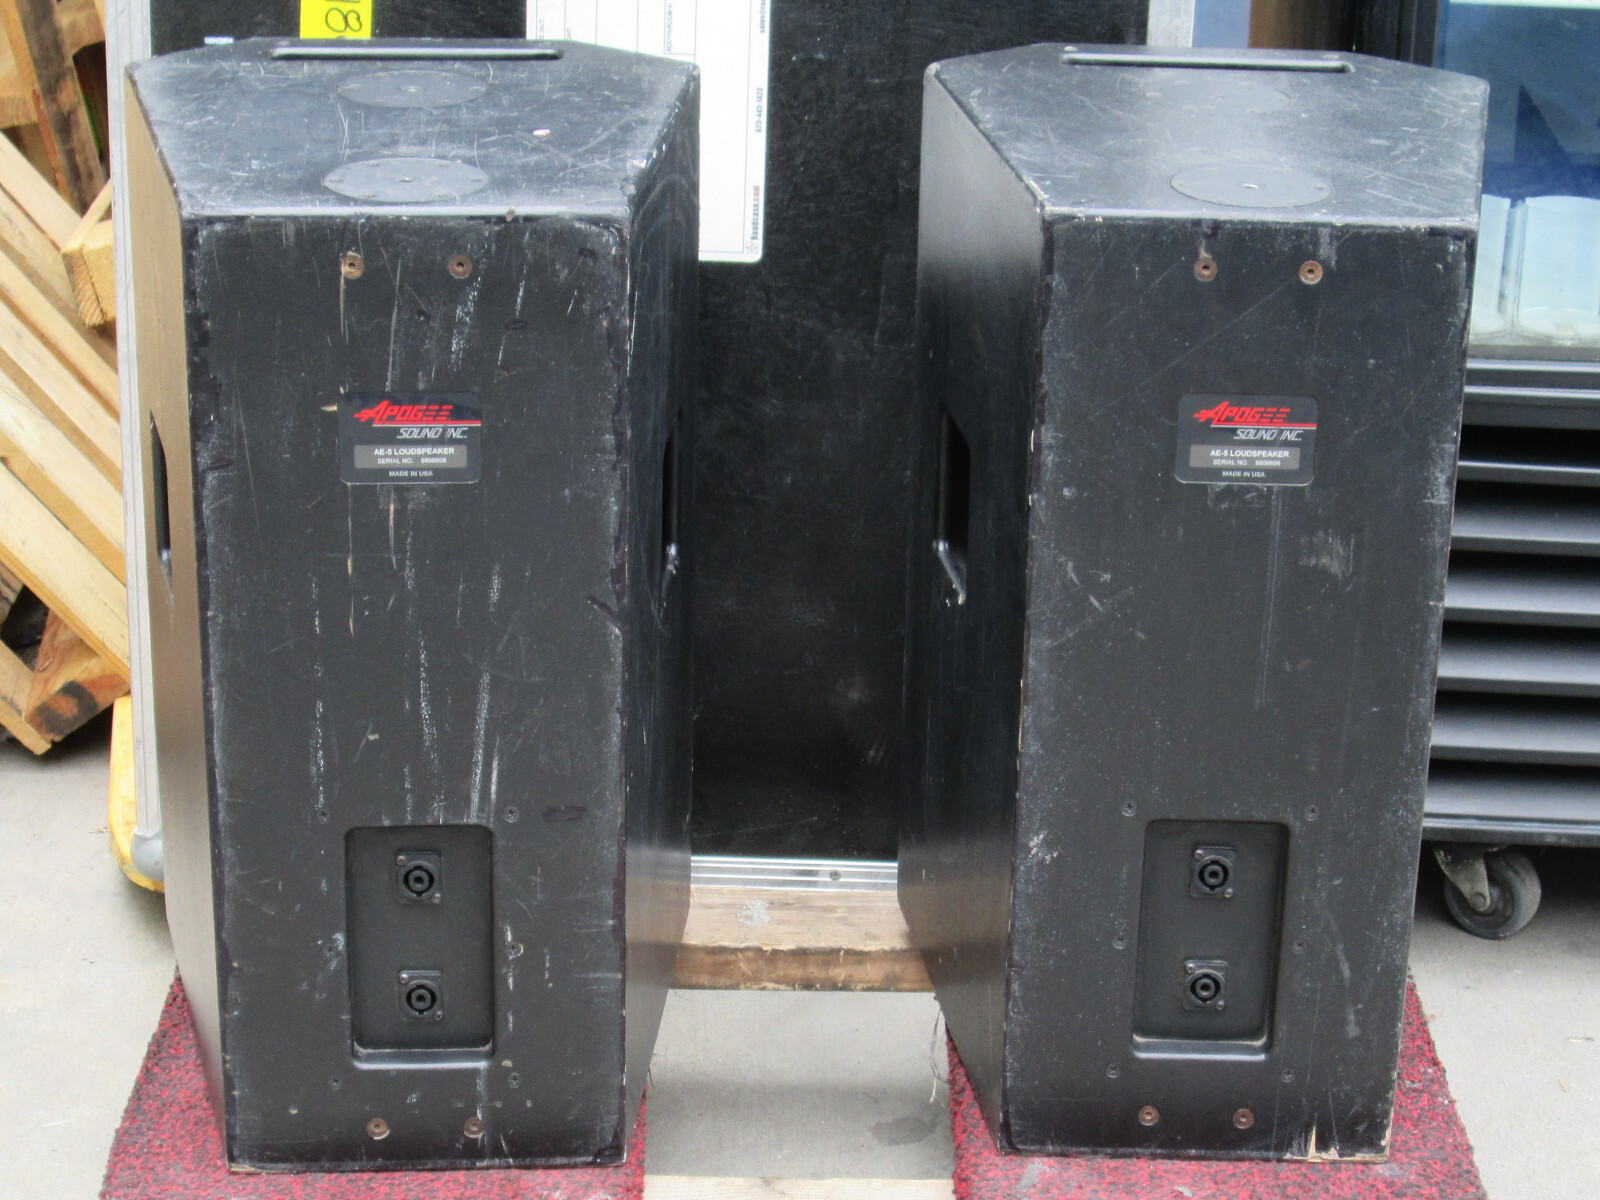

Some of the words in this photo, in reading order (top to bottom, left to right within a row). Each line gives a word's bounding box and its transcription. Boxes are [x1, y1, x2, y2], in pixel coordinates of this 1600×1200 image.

[353, 400, 454, 423] APOGEE
[1193, 401, 1291, 424] APOGEE
[396, 427, 442, 439] SOUND
[445, 427, 468, 439] INC.
[1233, 428, 1277, 440] SOUND
[1280, 430, 1304, 441] INC.
[394, 447, 455, 456] LOUDSPEAKER
[1230, 449, 1290, 458] LOUDSPEAKER
[377, 457, 401, 465] SERIAL
[1213, 458, 1235, 466] SERIAL
